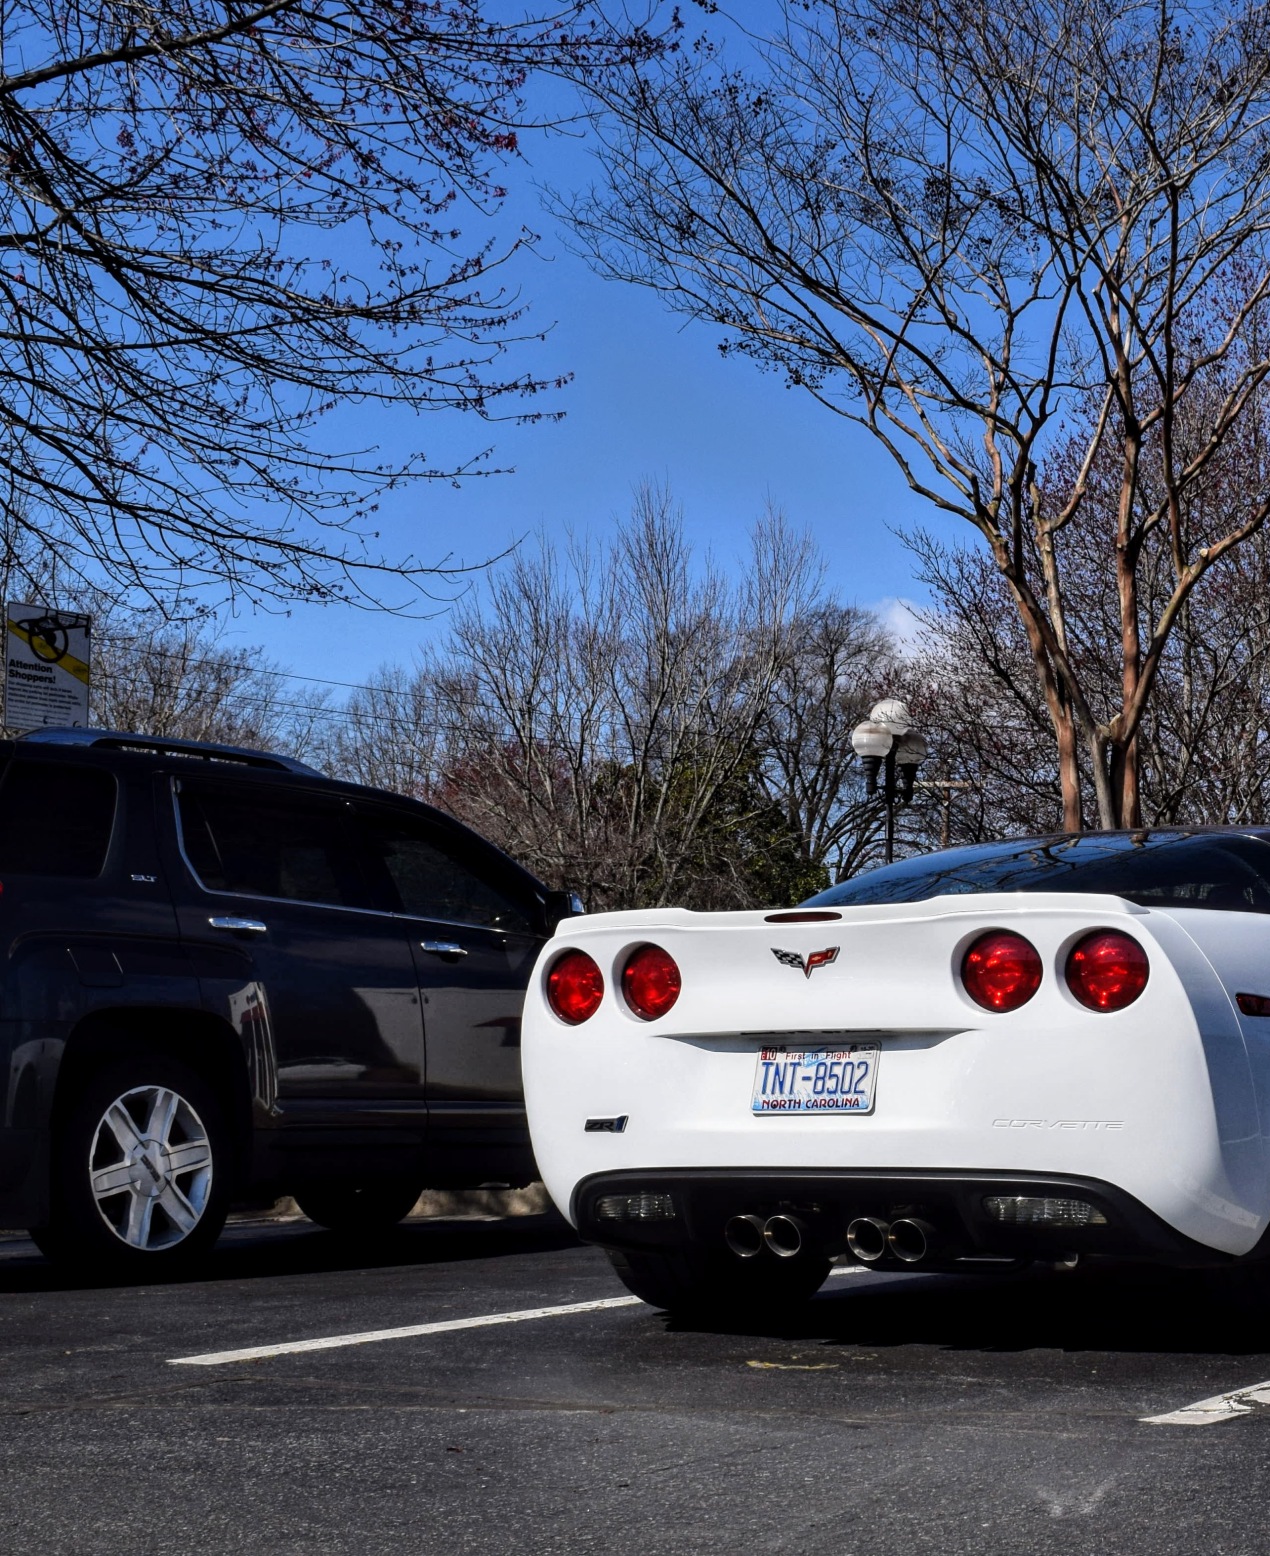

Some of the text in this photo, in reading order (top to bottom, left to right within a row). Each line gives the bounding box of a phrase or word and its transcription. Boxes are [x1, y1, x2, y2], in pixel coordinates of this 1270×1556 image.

[8, 658, 53, 674] Attention
[8, 669, 56, 684] Shoppers!
[130, 874, 158, 883] SLT
[785, 1051, 851, 1061] First in Flight
[761, 1061, 869, 1095] TNT-8502
[761, 1097, 860, 1109] NORTH CAROLINA
[992, 1118, 1126, 1130] CORVETTE
